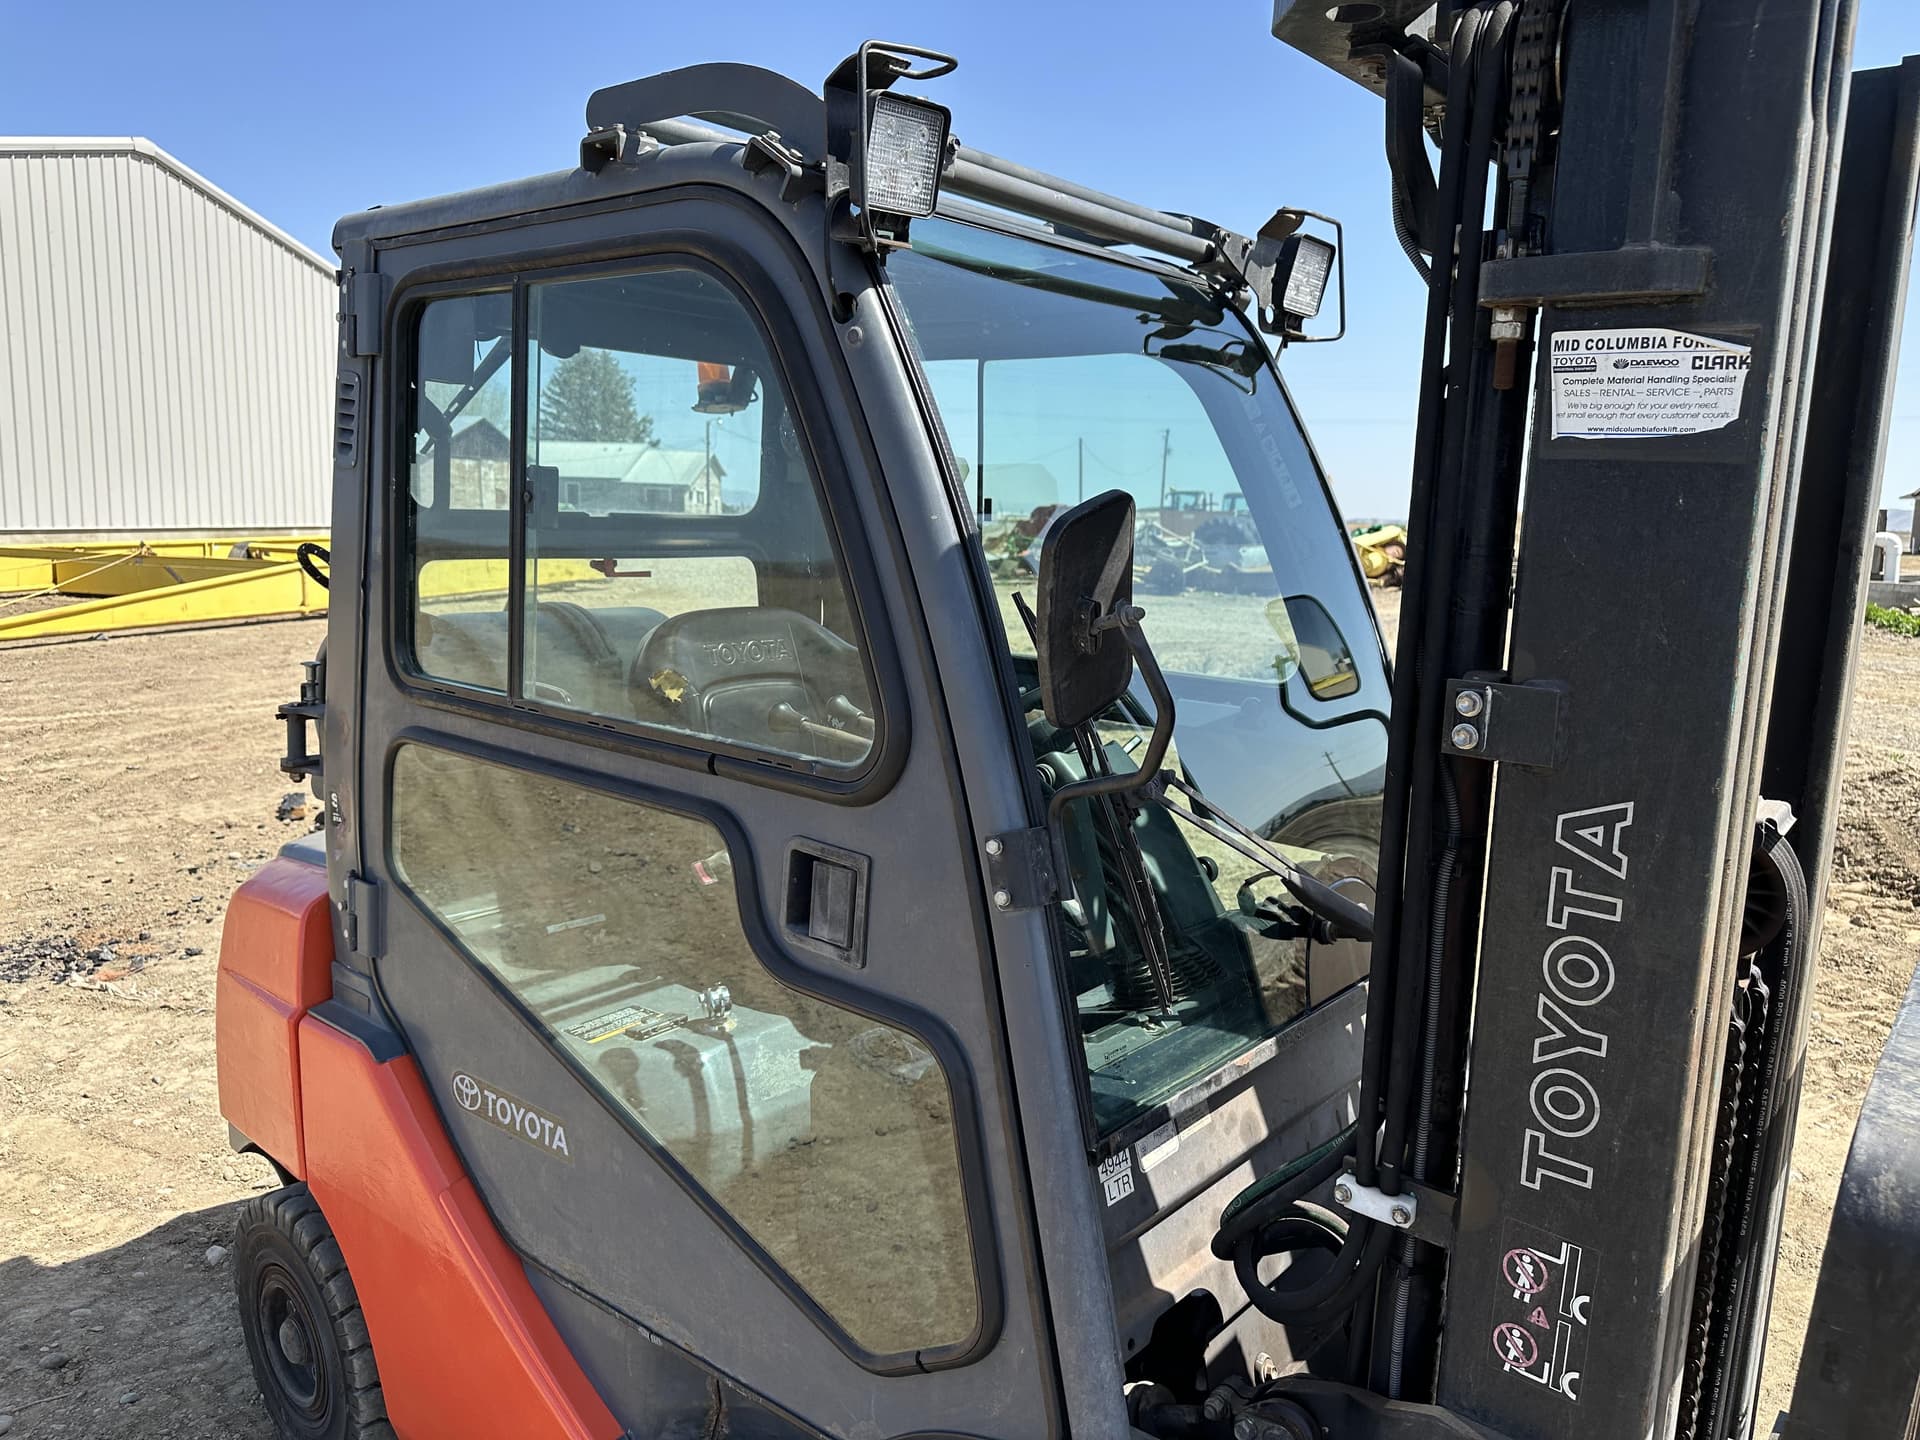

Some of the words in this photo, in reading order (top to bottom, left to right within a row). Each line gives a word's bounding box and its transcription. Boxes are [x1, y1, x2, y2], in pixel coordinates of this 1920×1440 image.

[1553, 339, 1580, 352] MID
[1585, 336, 1667, 351] COLUMBIA
[1554, 356, 1597, 366] TOYOTA
[1691, 355, 1751, 370] CLARK
[1562, 377, 1605, 386] Complete
[1607, 376, 1645, 385] Material
[1647, 375, 1690, 386] Handling
[1692, 375, 1737, 385] Specialist
[1563, 389, 1591, 397] SALES
[1599, 388, 1636, 397] RENTAL
[1646, 387, 1691, 397] SERVICE
[1703, 387, 1734, 396] PARTS
[1589, 402, 1602, 411] big
[1604, 402, 1635, 411] enough
[1650, 403, 1668, 411] your
[1587, 412, 1618, 420] enough
[1661, 411, 1700, 419] customer
[1587, 425, 1697, 433] www.midcolumbiaforklift.com
[704, 638, 792, 666] TOYOTA
[1521, 801, 1634, 1190] TOYOTA
[484, 1089, 569, 1156] TOYOTA
[1101, 1150, 1129, 1176] 4944
[1107, 1173, 1132, 1201] LTR
